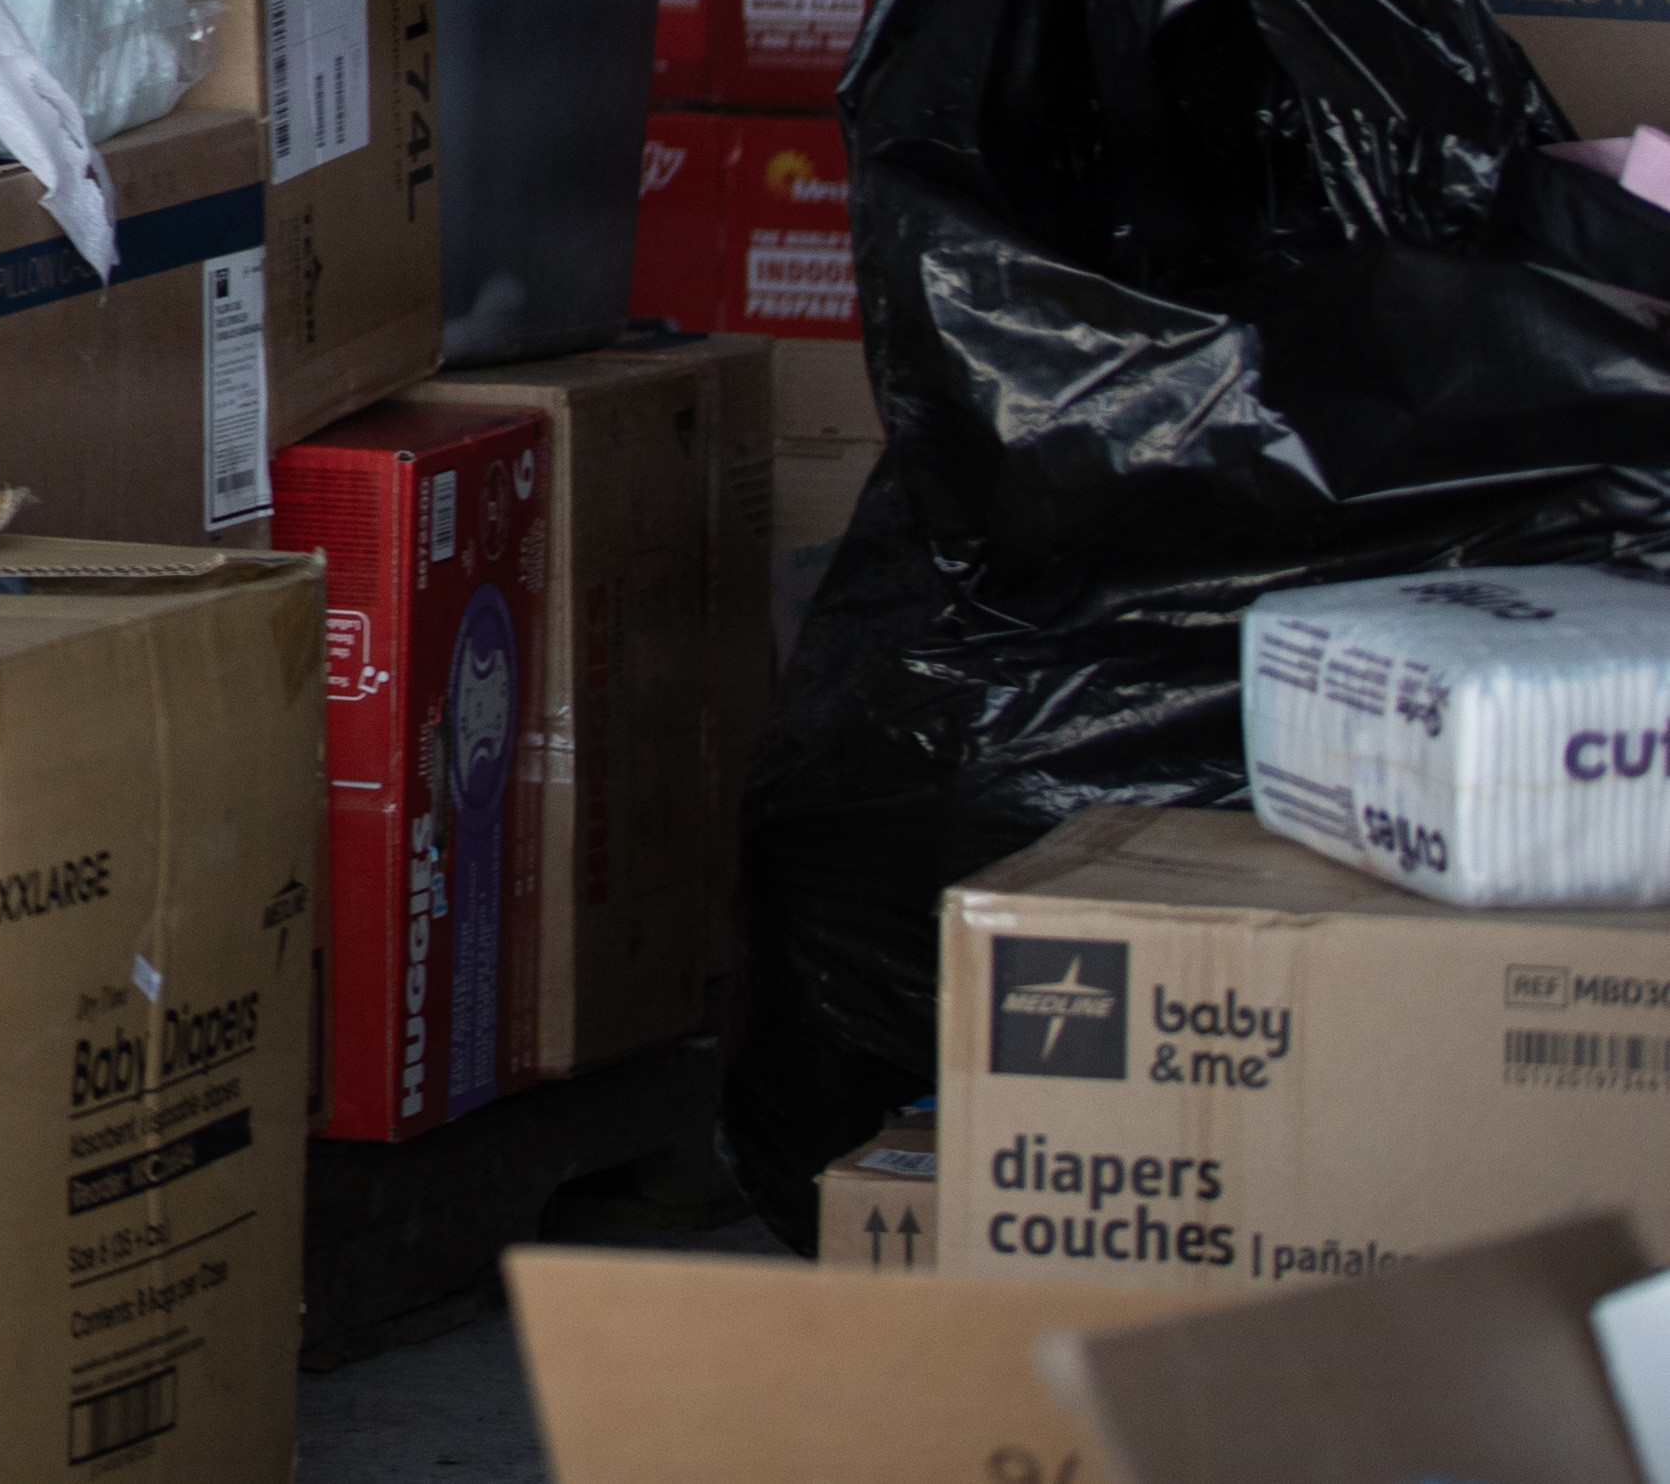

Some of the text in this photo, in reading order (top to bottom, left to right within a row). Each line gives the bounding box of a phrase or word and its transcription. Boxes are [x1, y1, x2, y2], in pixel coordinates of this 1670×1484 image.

[512, 447, 536, 502] 6
[1363, 801, 1449, 876] cuties
[400, 815, 435, 1118] HUGGIES
[1512, 975, 1560, 1000] REF
[1000, 989, 1118, 1021] MEDLINE
[1151, 984, 1292, 1058] baby
[71, 990, 261, 1109] Baby Diapers
[989, 1134, 1223, 1212] diapers
[986, 1204, 1237, 1269] couches
